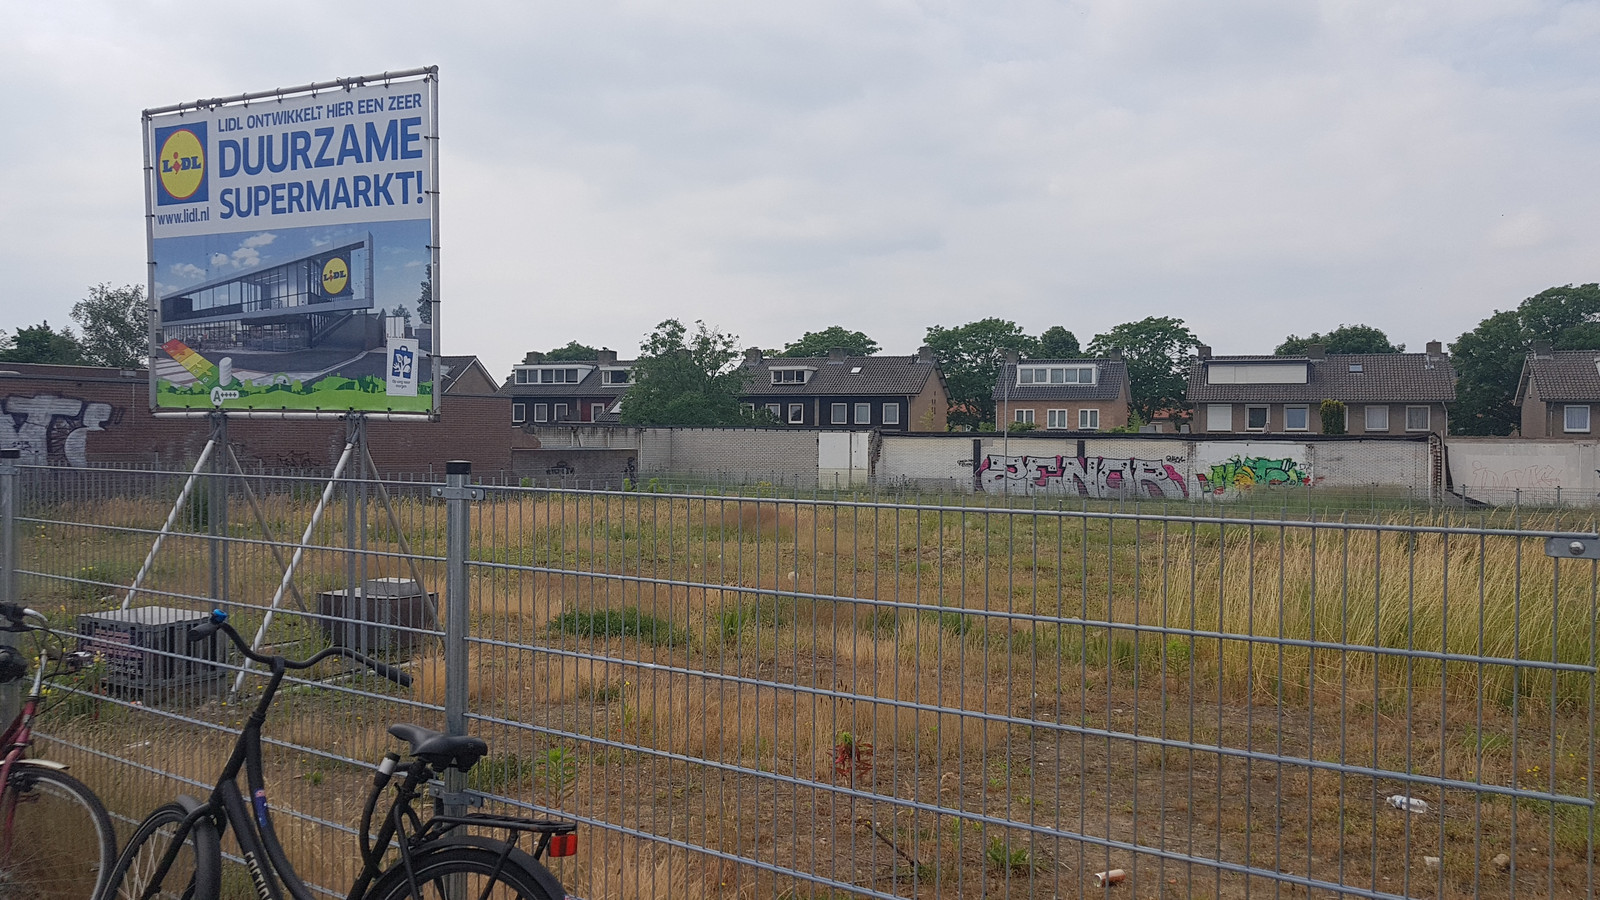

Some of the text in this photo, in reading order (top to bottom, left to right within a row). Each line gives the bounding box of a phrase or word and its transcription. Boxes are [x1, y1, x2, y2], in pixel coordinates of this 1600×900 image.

[218, 93, 422, 132] LIDL ONTWIKKELT HIER EEN ZEER
[218, 116, 423, 178] DUURZAME
[157, 207, 210, 225] www.lidl.nl
[219, 170, 423, 220] SUPERMARKT!
